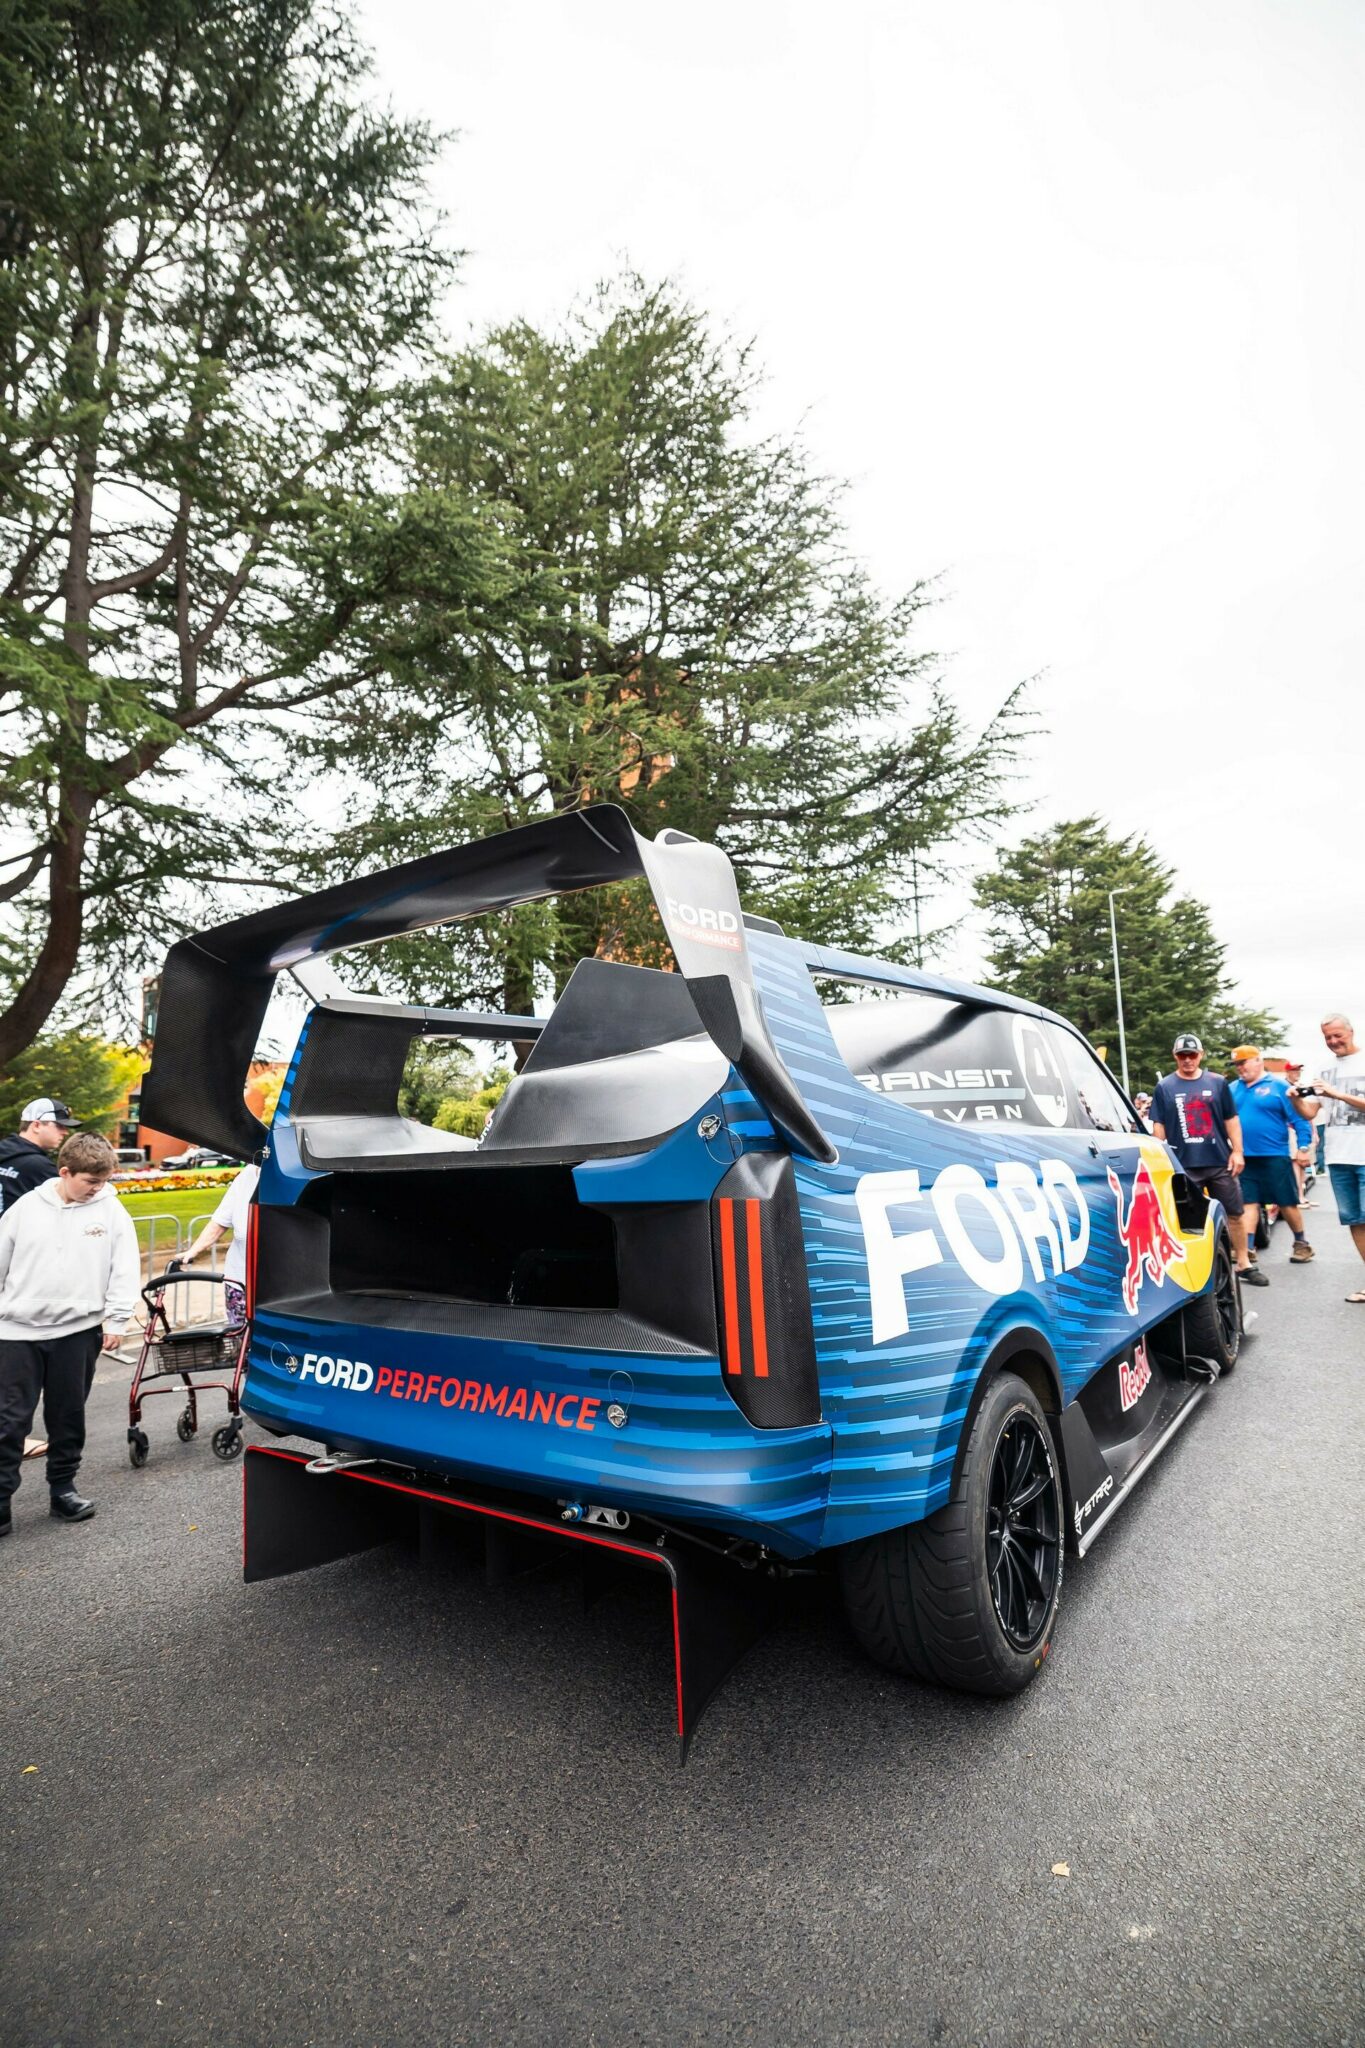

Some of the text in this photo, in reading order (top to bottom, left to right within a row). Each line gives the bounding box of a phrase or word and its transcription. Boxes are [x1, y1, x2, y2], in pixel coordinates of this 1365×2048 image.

[665, 897, 738, 932] FORD
[854, 1069, 1013, 1092] RANSIT
[855, 1159, 1090, 1345] FORD
[300, 1353, 600, 1432] FORD PERFORMANCE
